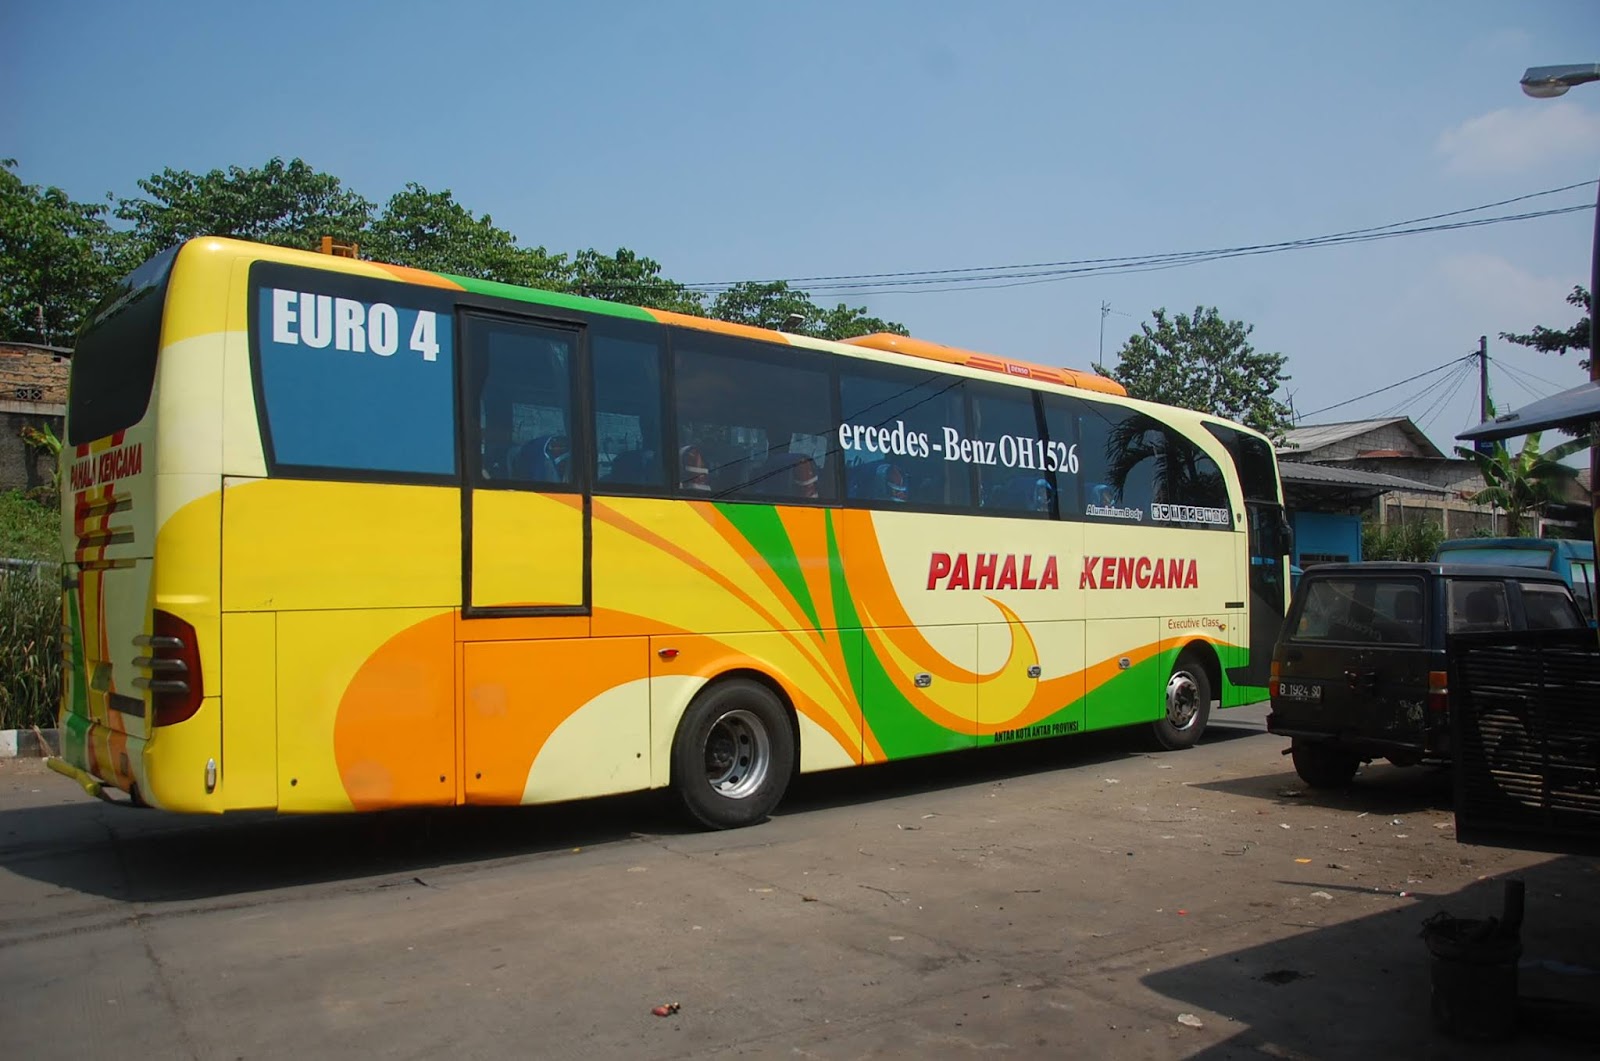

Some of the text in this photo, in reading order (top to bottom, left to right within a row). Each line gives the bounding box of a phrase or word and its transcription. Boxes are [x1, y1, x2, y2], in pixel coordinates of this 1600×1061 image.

[273, 288, 440, 361] EURO 4
[98, 443, 142, 484] KENCANA
[926, 552, 1199, 591] PAHALA KENCANA
[1168, 617, 1220, 630] Executive Class
[1279, 683, 1286, 695] B
[994, 720, 1079, 743] ANTAR KOTA ANTAR PROVINSI
